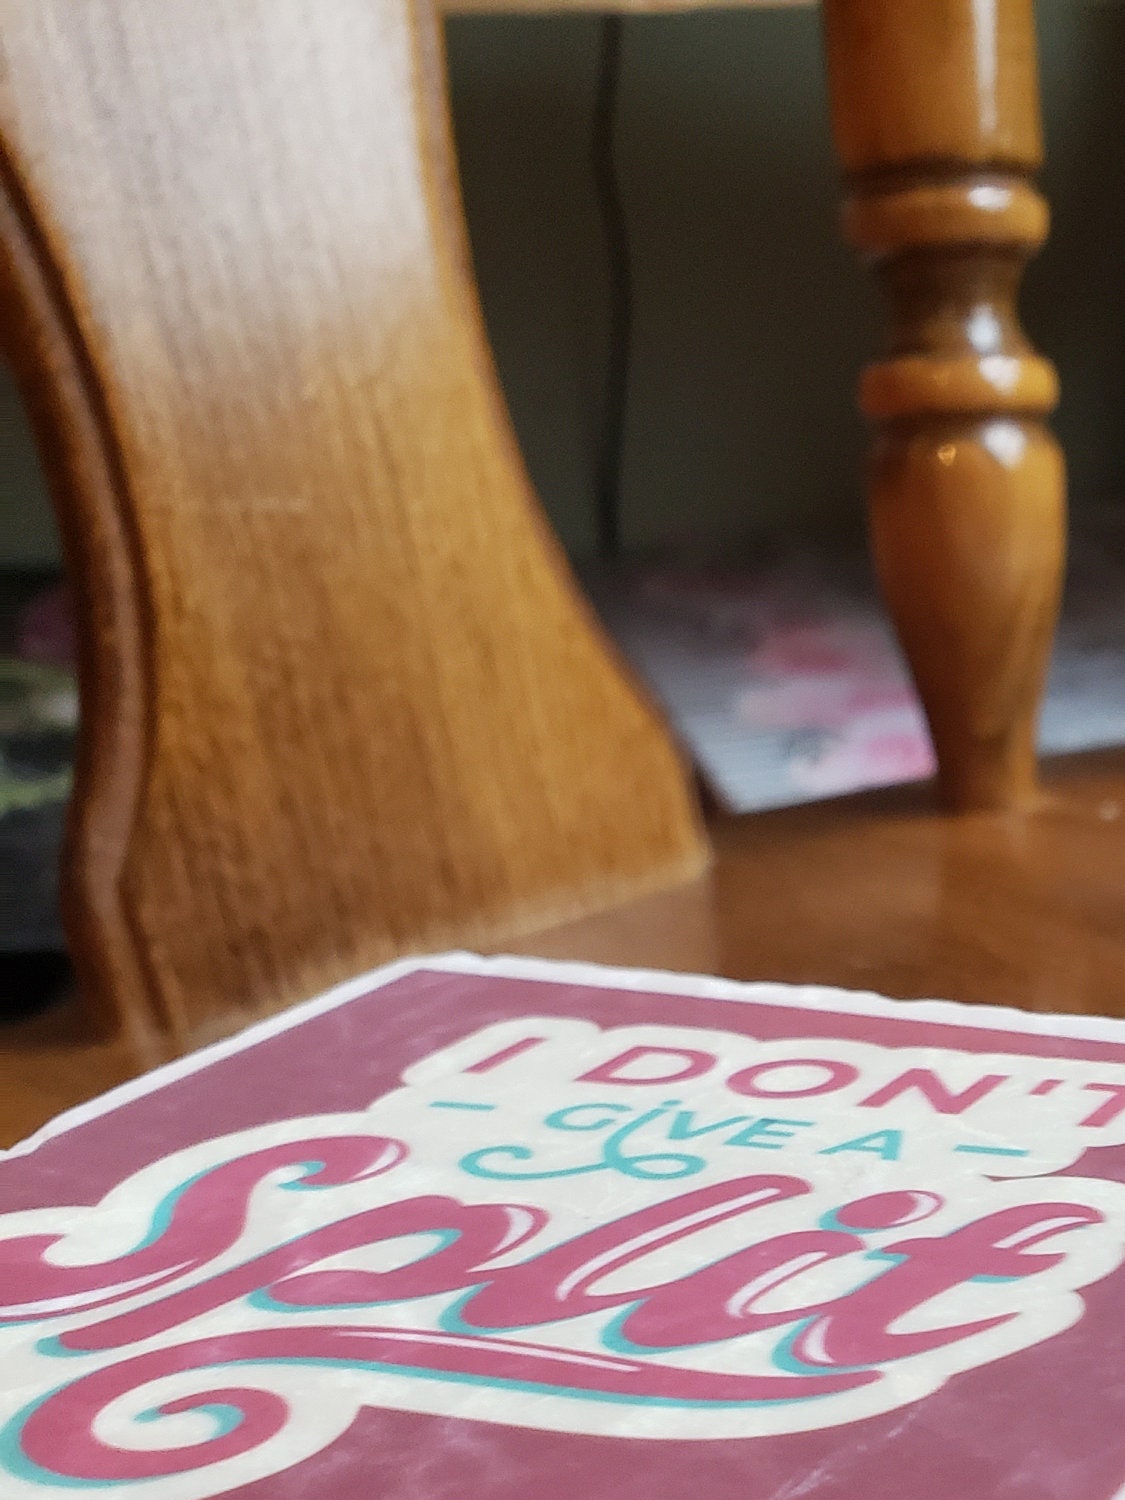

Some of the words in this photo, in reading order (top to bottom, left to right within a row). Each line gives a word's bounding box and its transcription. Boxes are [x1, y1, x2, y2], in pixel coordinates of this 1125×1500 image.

[461, 1036, 548, 1074] I
[816, 1129, 904, 1161] A
[0, 1135, 1107, 1374] Split
